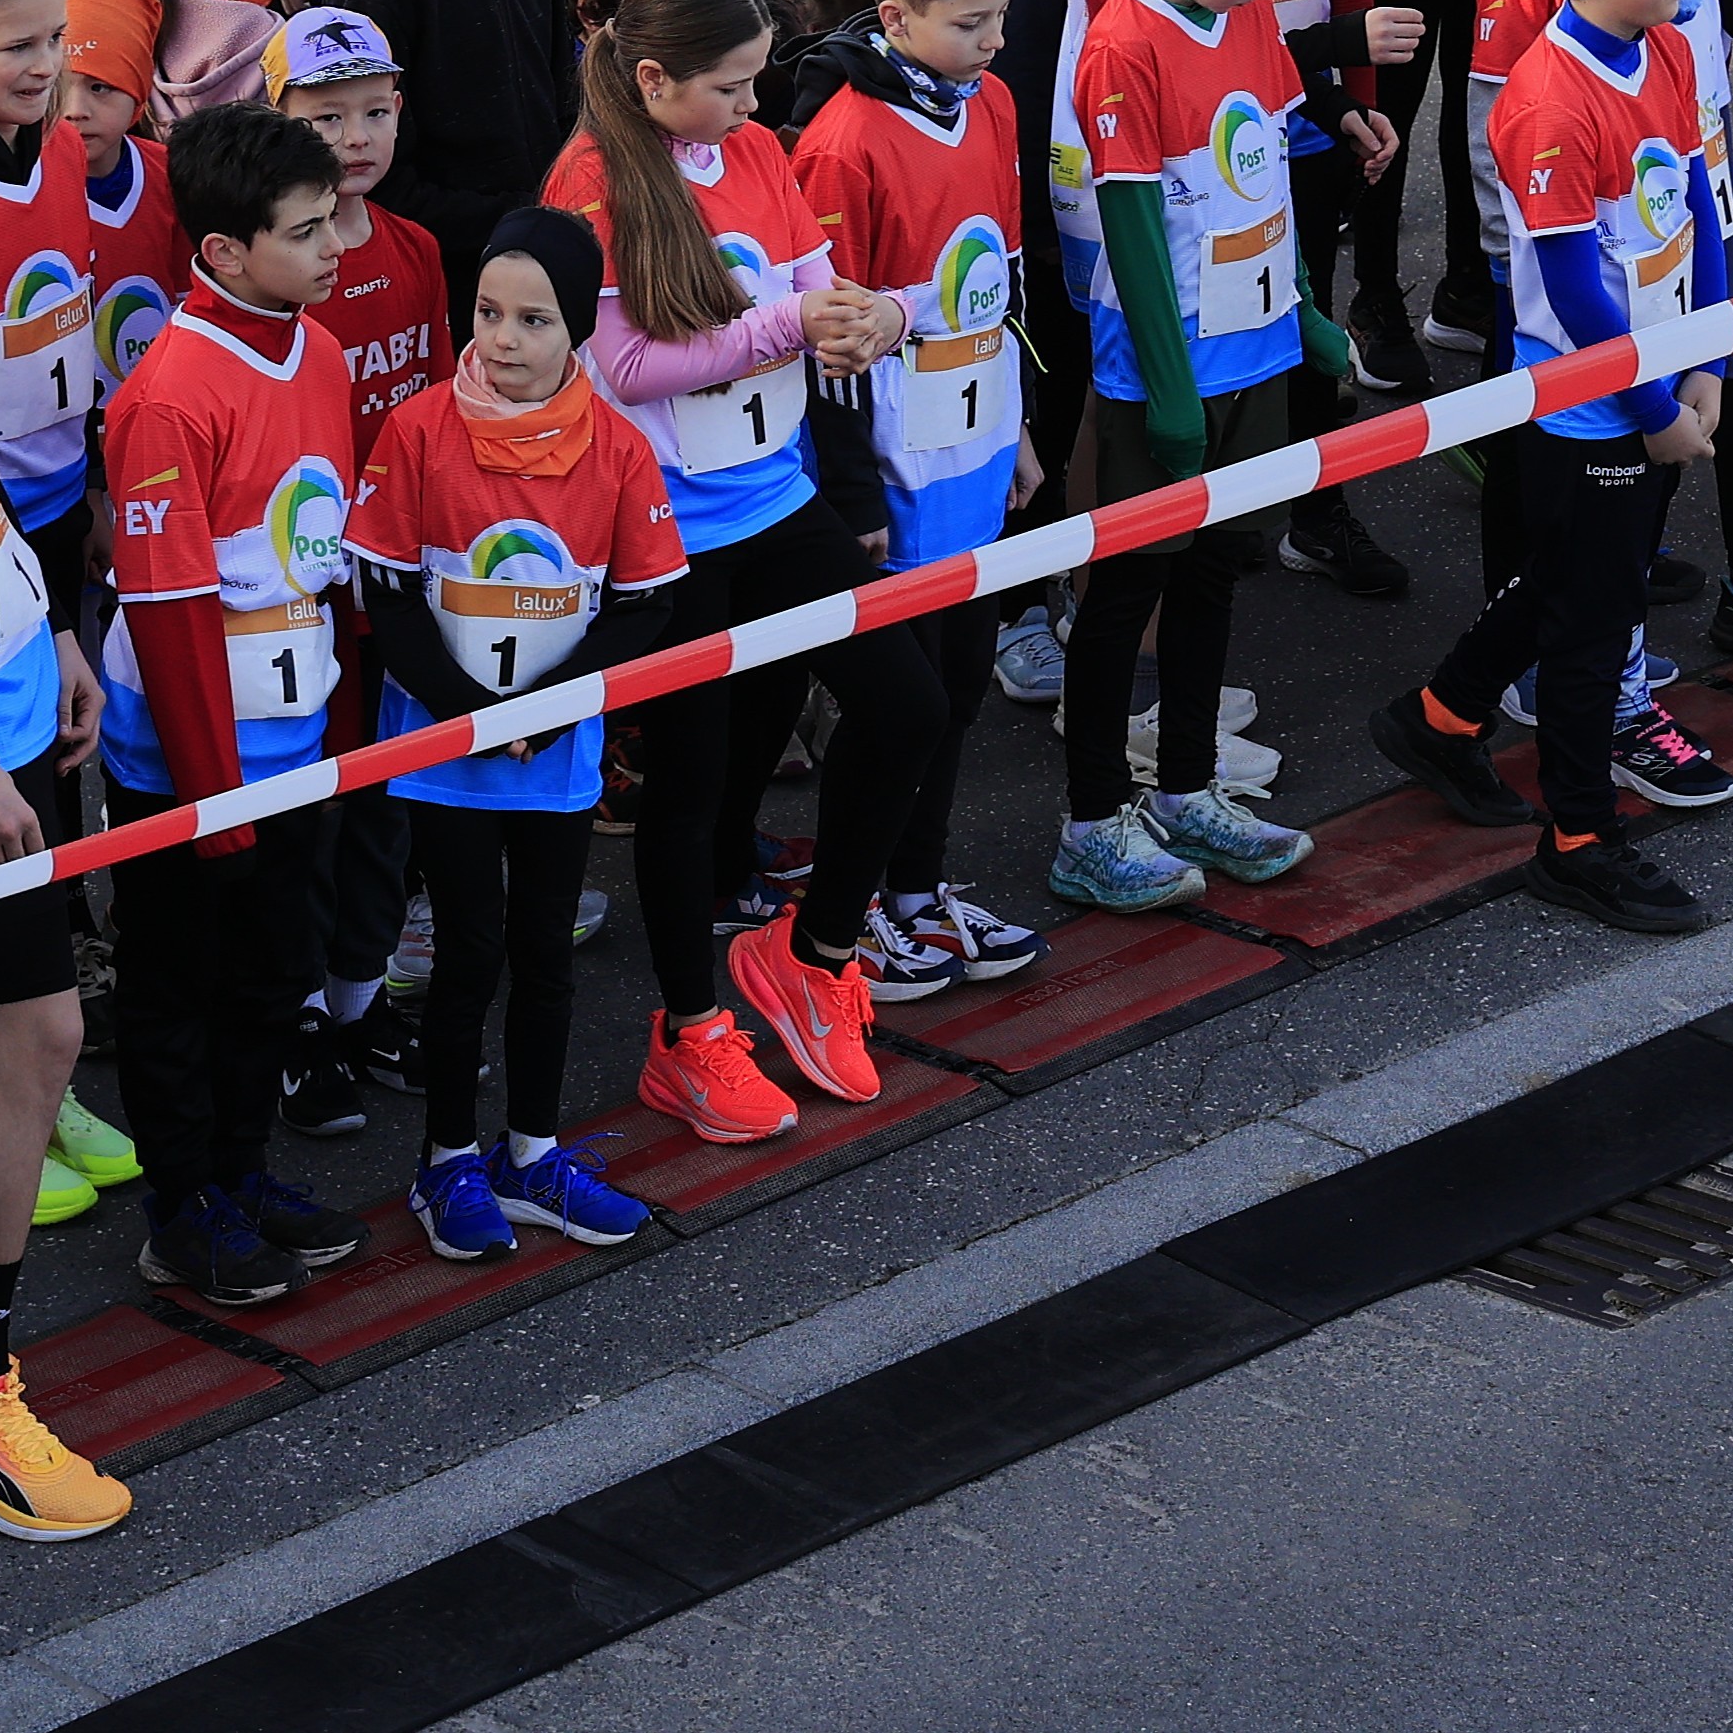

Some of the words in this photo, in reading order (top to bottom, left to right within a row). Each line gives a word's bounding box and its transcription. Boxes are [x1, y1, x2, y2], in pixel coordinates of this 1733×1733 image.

[1236, 145, 1266, 174] POST
[1715, 178, 1733, 225] 1
[1262, 220, 1286, 243] lalux
[344, 278, 381, 299] CRAFT
[968, 282, 1001, 316] POST
[1256, 265, 1272, 316] 1
[1674, 274, 1687, 315] 1
[54, 305, 86, 332] lalux
[49, 355, 70, 410] 1
[741, 392, 767, 446] 1
[961, 378, 979, 431] 1
[1585, 461, 1647, 477] Lombardi
[1598, 476, 1635, 487] sports
[355, 477, 378, 507] Y
[125, 499, 172, 536] EY
[294, 534, 340, 561] POS
[300, 556, 344, 574] LUXEMBOU
[285, 601, 320, 622] lalu
[513, 611, 566, 621] ASSURANCES
[514, 590, 566, 613] lalux
[490, 635, 517, 688] 1
[270, 648, 299, 705] 1
